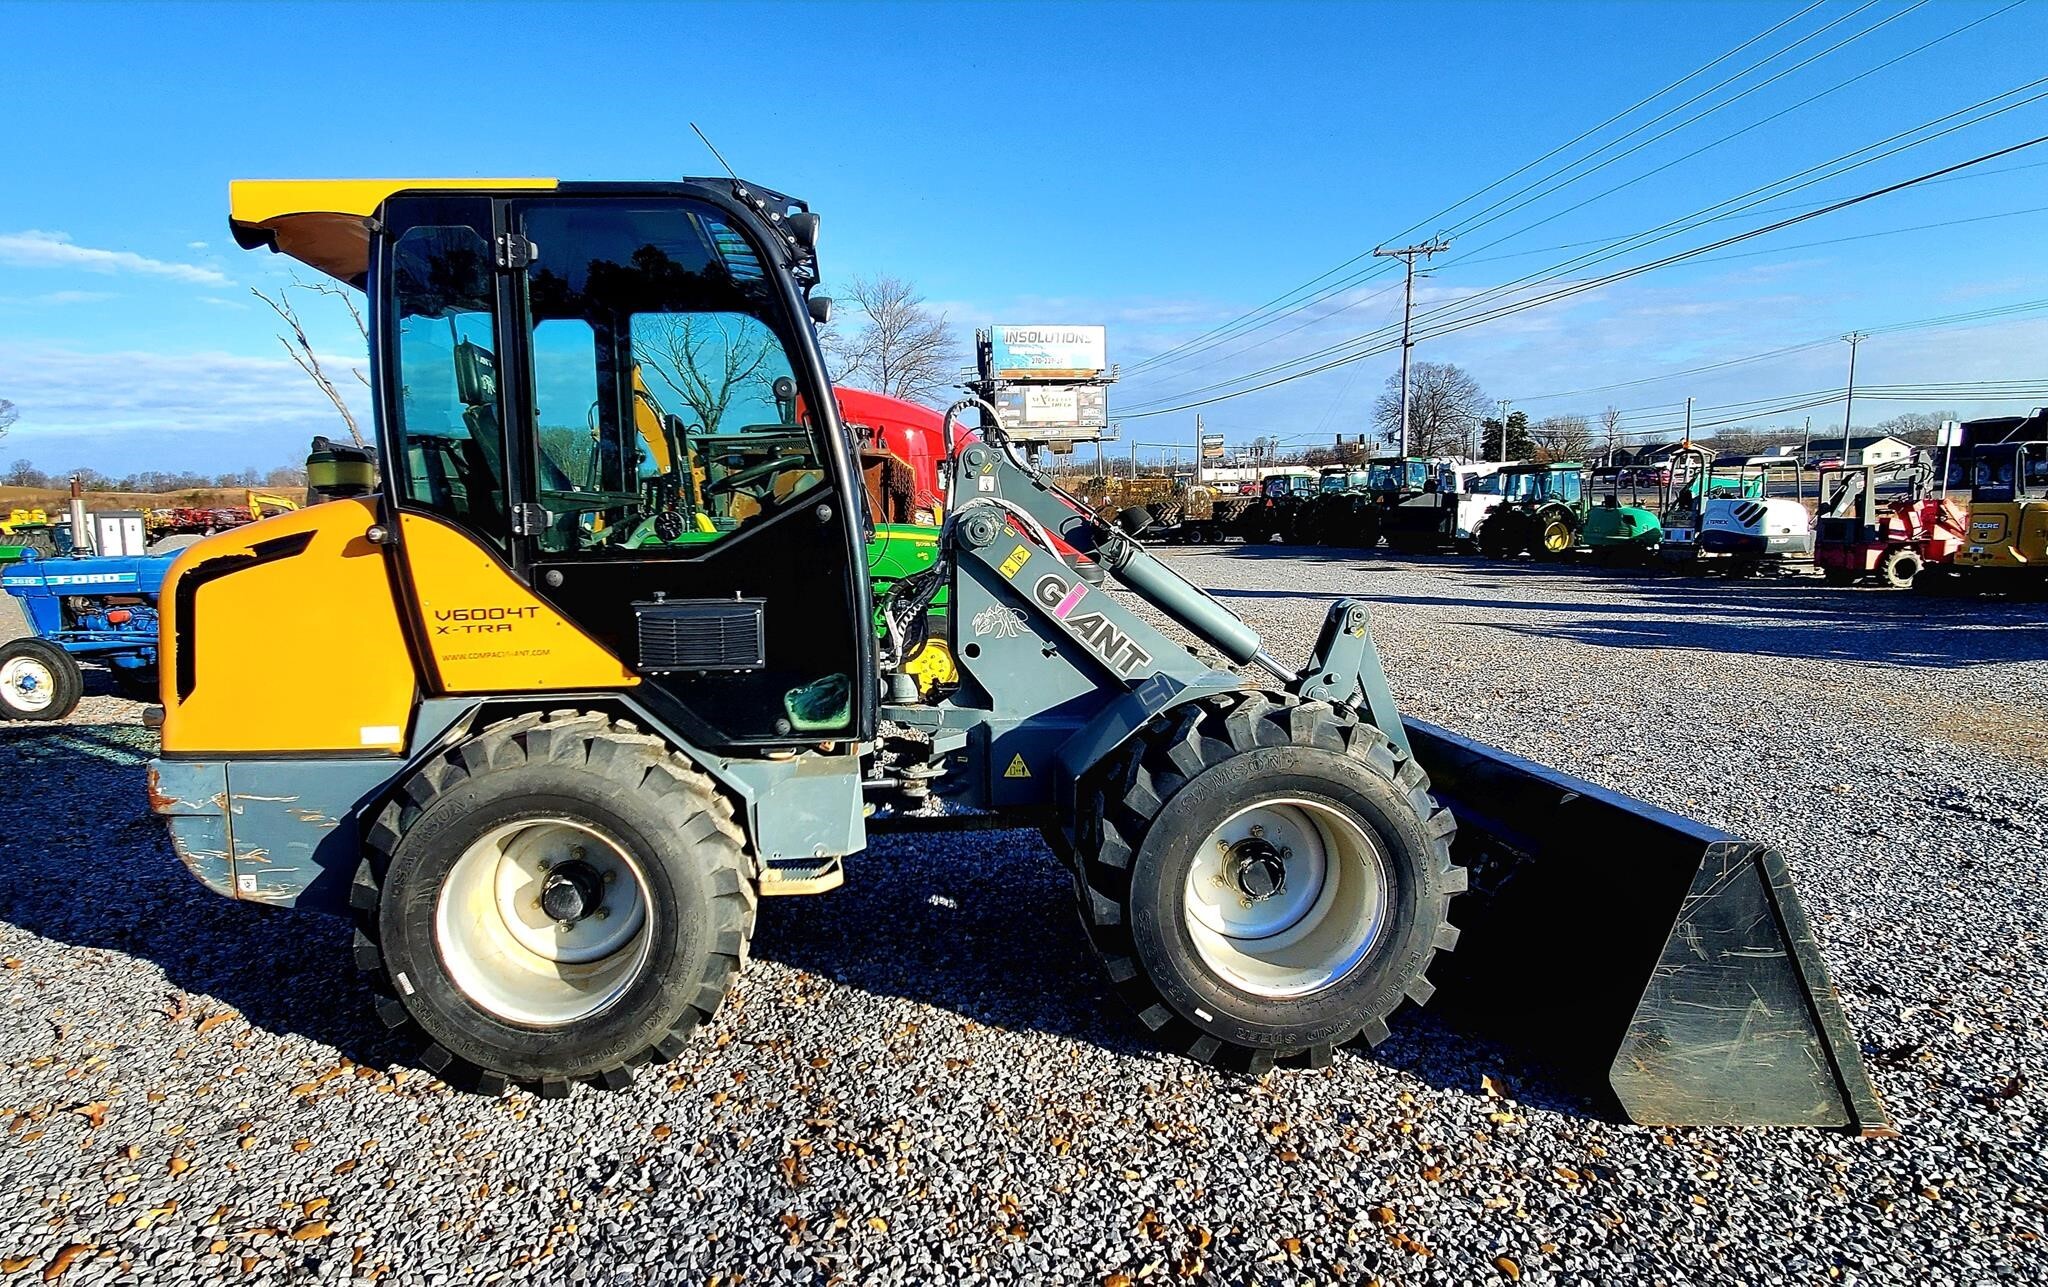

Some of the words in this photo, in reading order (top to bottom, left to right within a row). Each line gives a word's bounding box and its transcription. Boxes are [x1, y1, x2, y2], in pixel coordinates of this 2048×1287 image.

[57, 574, 120, 585] FORD
[434, 606, 540, 622] V6004T
[435, 623, 513, 635] X-TRA
[441, 649, 551, 662] WWW.COMPACTANT.COM
[1180, 754, 1287, 816] SAMSON
[1235, 1026, 1297, 1045] STEER
